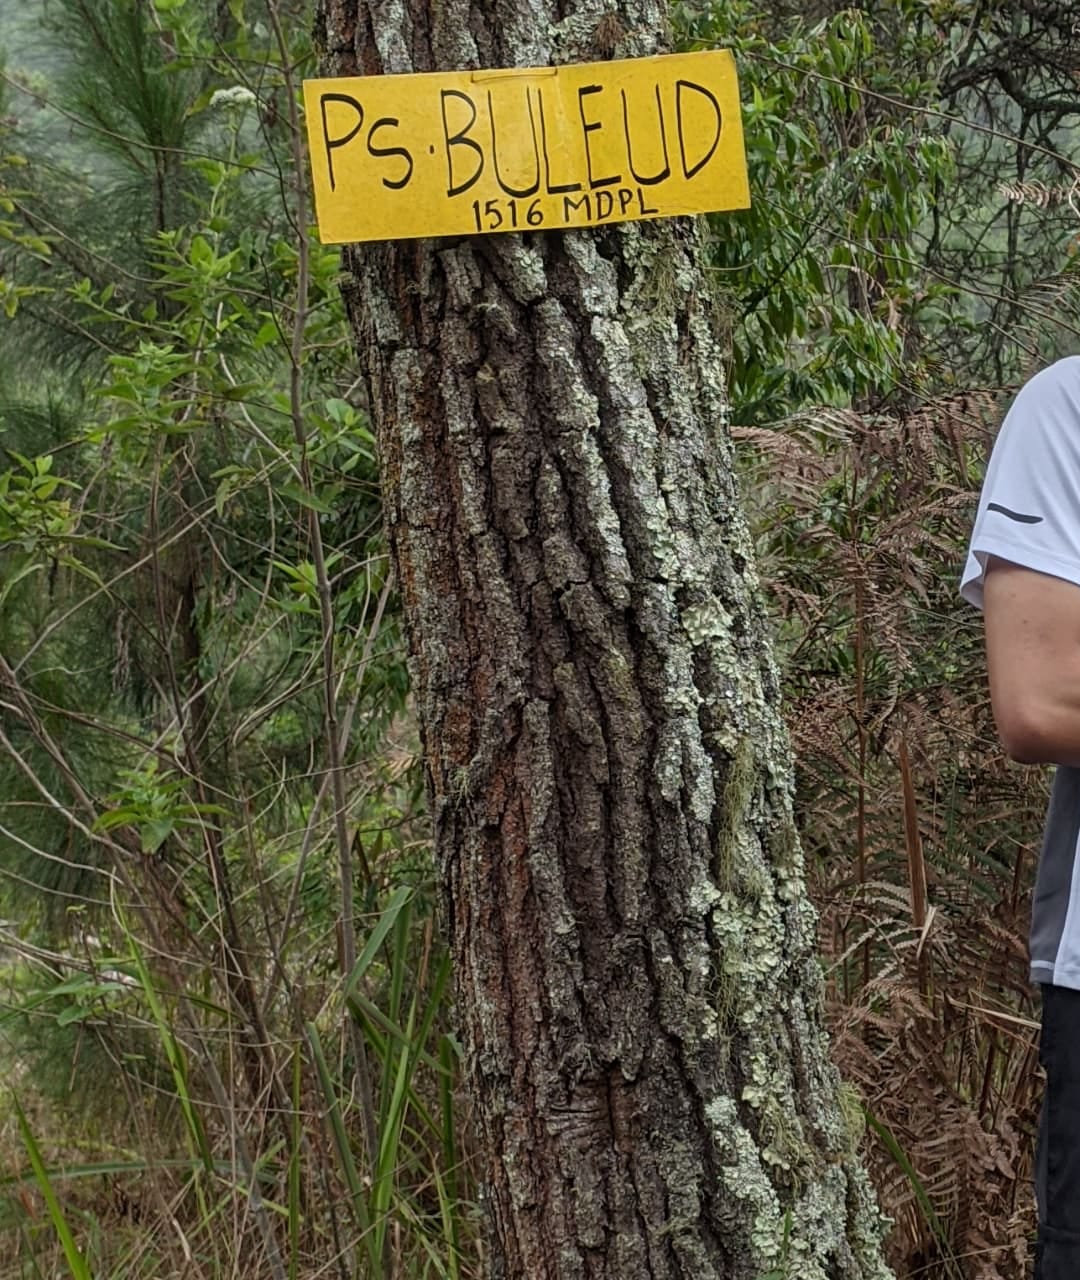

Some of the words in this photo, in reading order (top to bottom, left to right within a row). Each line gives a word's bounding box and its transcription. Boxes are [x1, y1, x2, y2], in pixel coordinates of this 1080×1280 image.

[440, 78, 723, 198] BULEUD
[471, 197, 545, 232] 1516
[563, 187, 660, 223] MDPL
